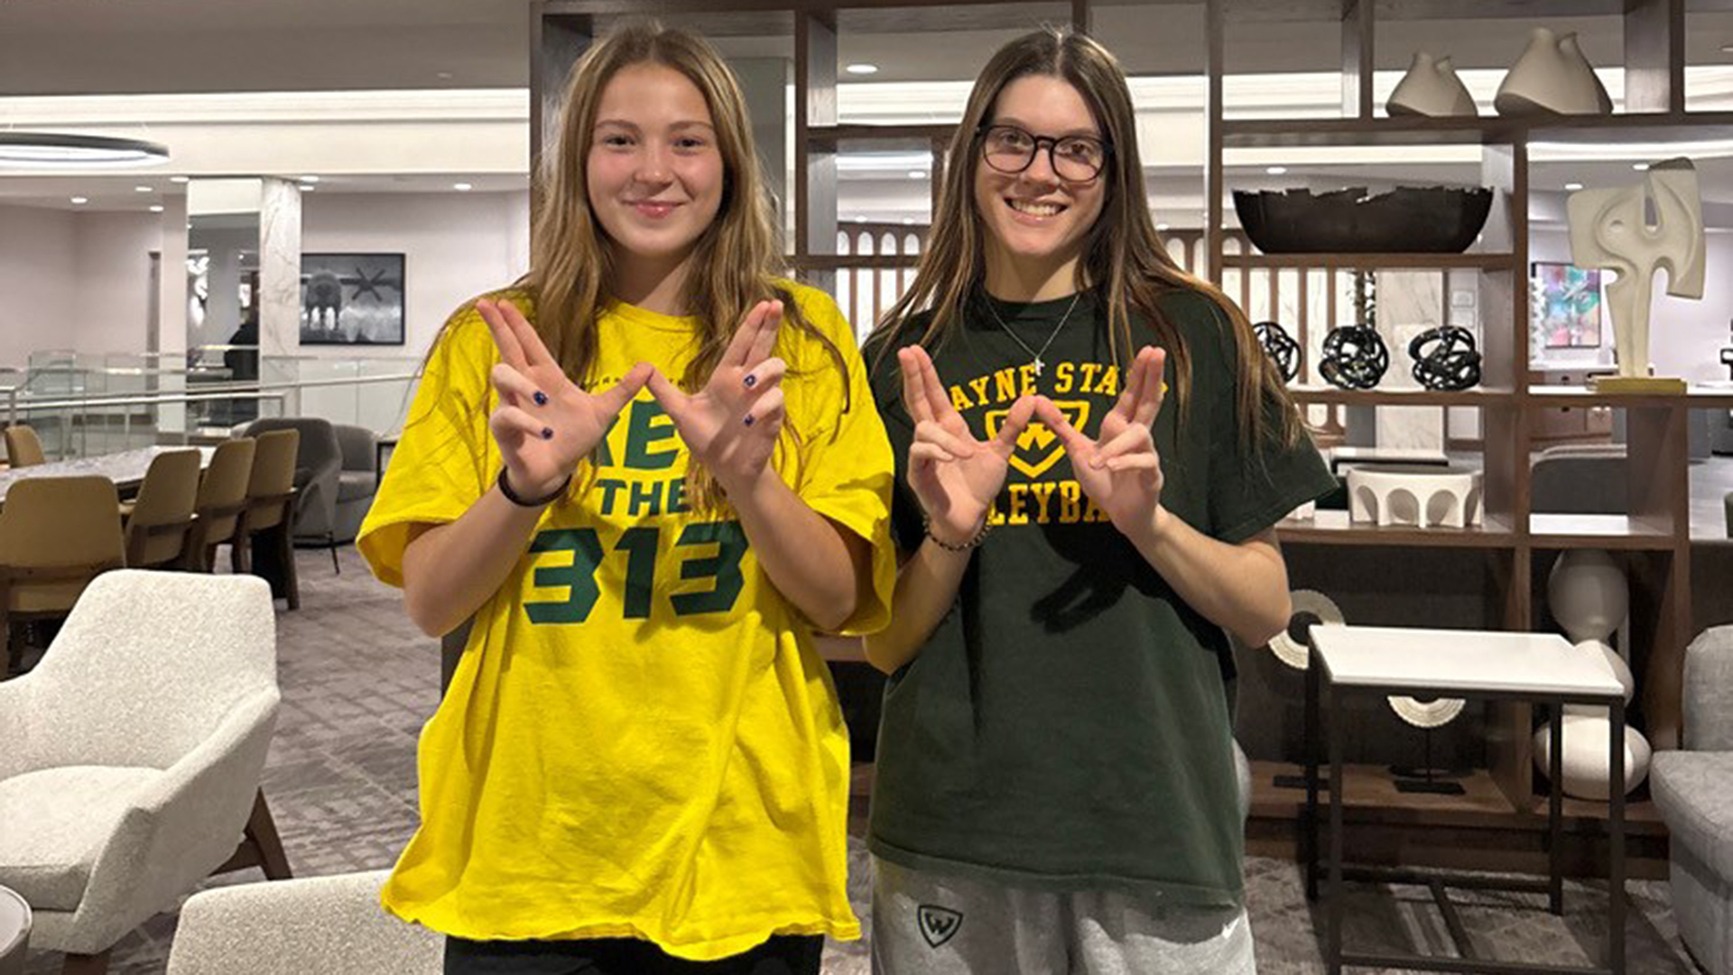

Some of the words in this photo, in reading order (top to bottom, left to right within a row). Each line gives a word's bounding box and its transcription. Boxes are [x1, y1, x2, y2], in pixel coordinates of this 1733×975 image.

[949, 364, 1038, 412] AYNE
[1054, 361, 1168, 396] STA
[596, 478, 691, 517] THE
[522, 520, 749, 626] 313
